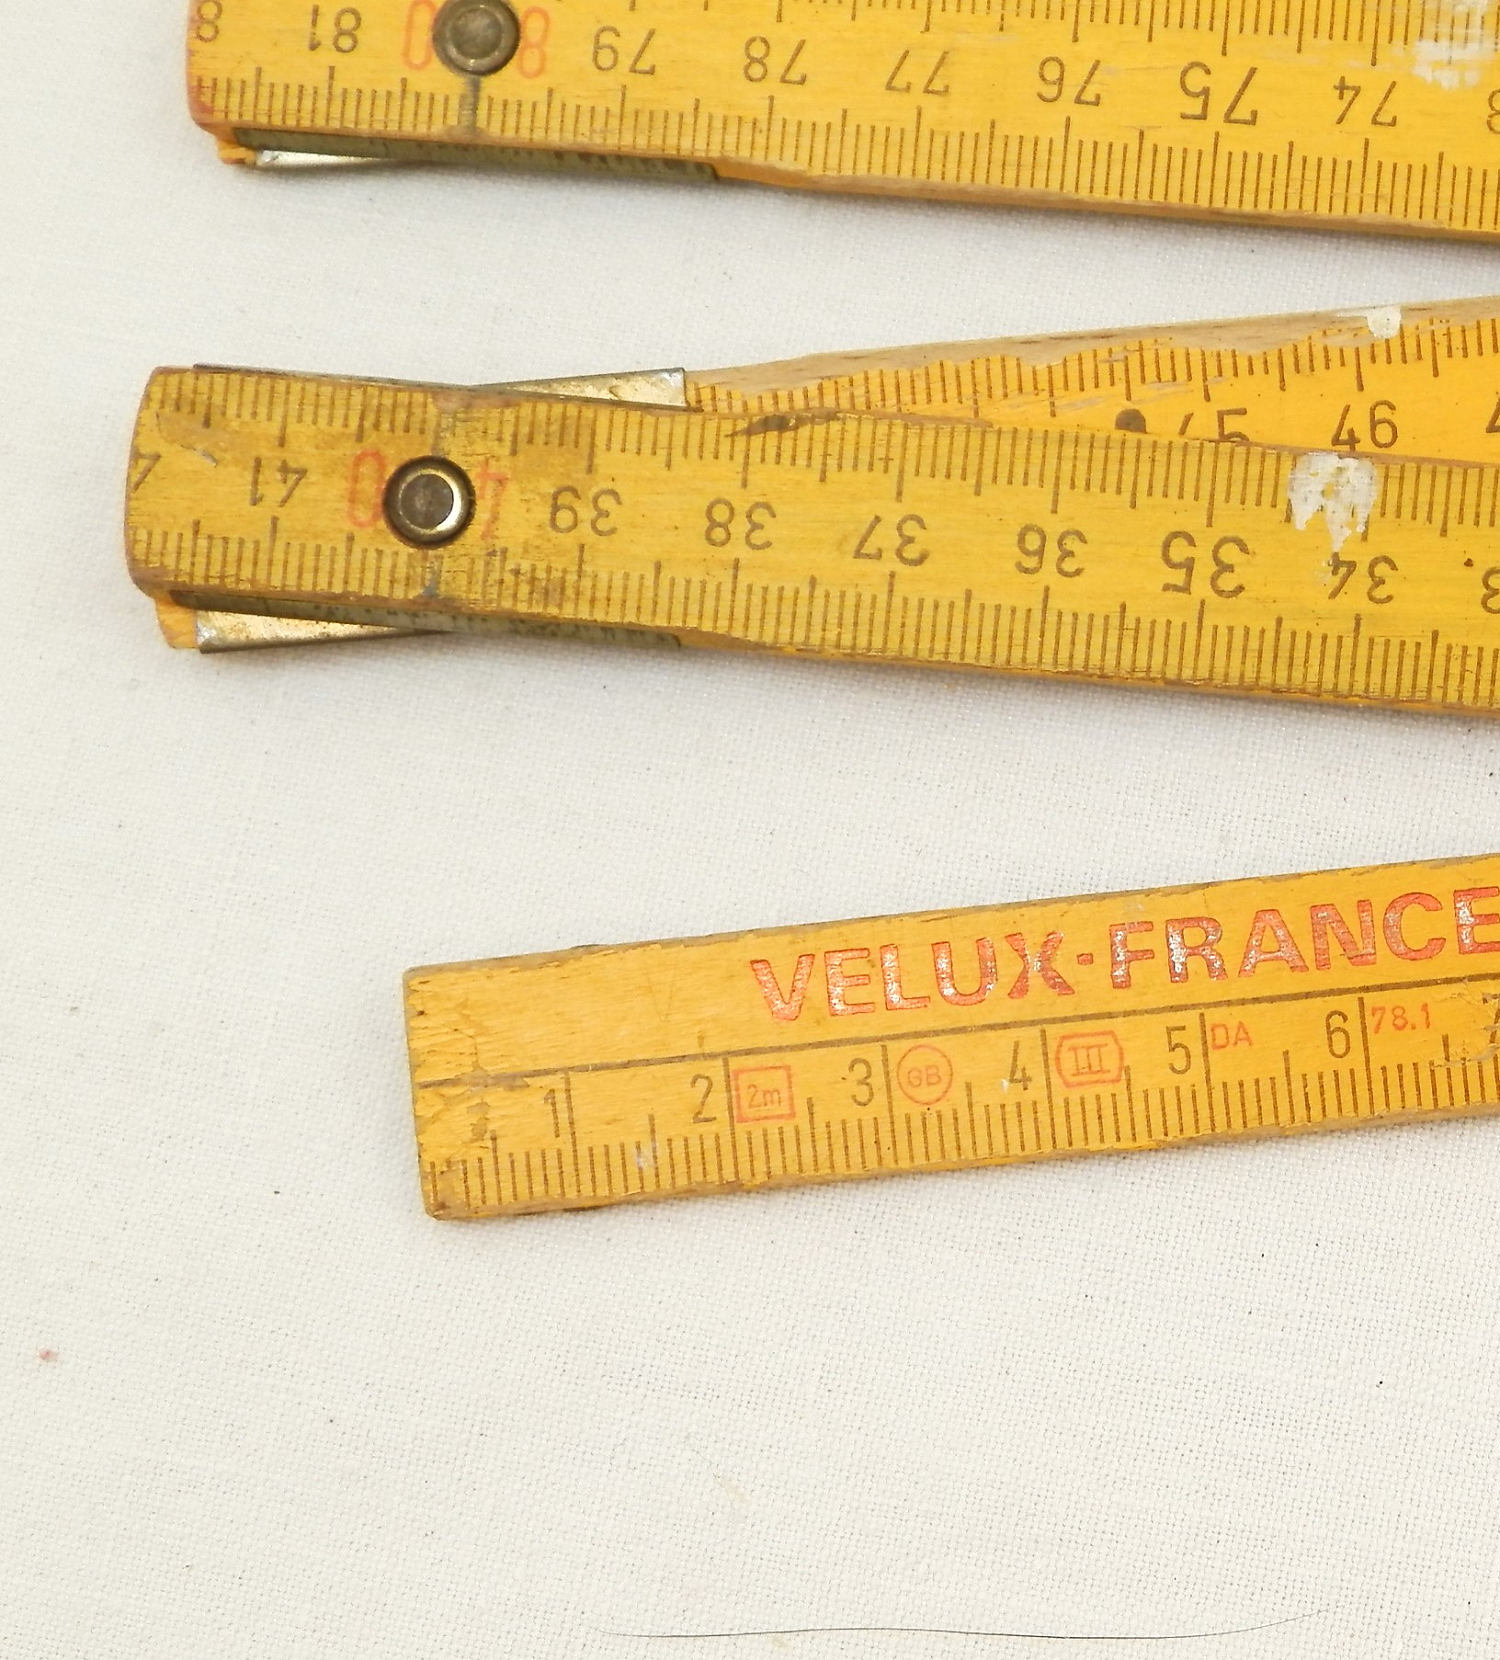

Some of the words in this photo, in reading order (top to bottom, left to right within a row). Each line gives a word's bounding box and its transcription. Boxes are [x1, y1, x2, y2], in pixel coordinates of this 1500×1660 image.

[307, 3, 362, 54] 81
[403, 0, 551, 79] 80
[591, 24, 657, 76] 79
[743, 35, 808, 87] 78
[884, 48, 952, 97] 77
[1036, 55, 1102, 108] 76
[1179, 60, 1259, 128] 75
[1332, 75, 1399, 129] 74
[1331, 399, 1399, 452] 46
[248, 456, 308, 508] 41
[346, 449, 510, 541] 40
[547, 484, 622, 537] 39
[704, 498, 778, 551] 38
[853, 513, 931, 567] 37
[1016, 522, 1089, 579] 36
[1160, 529, 1250, 599] 35
[1326, 551, 1399, 604] 34
[1209, 1021, 1254, 1051] DA
[1370, 1002, 1431, 1035] 78.1
[543, 1087, 561, 1138] 1
[689, 1073, 717, 1124] 2
[848, 1057, 875, 1108] 3
[1008, 1040, 1033, 1091] 4
[1164, 1024, 1193, 1075] 5
[1324, 1009, 1352, 1060] 6
[745, 1082, 783, 1110] 2m
